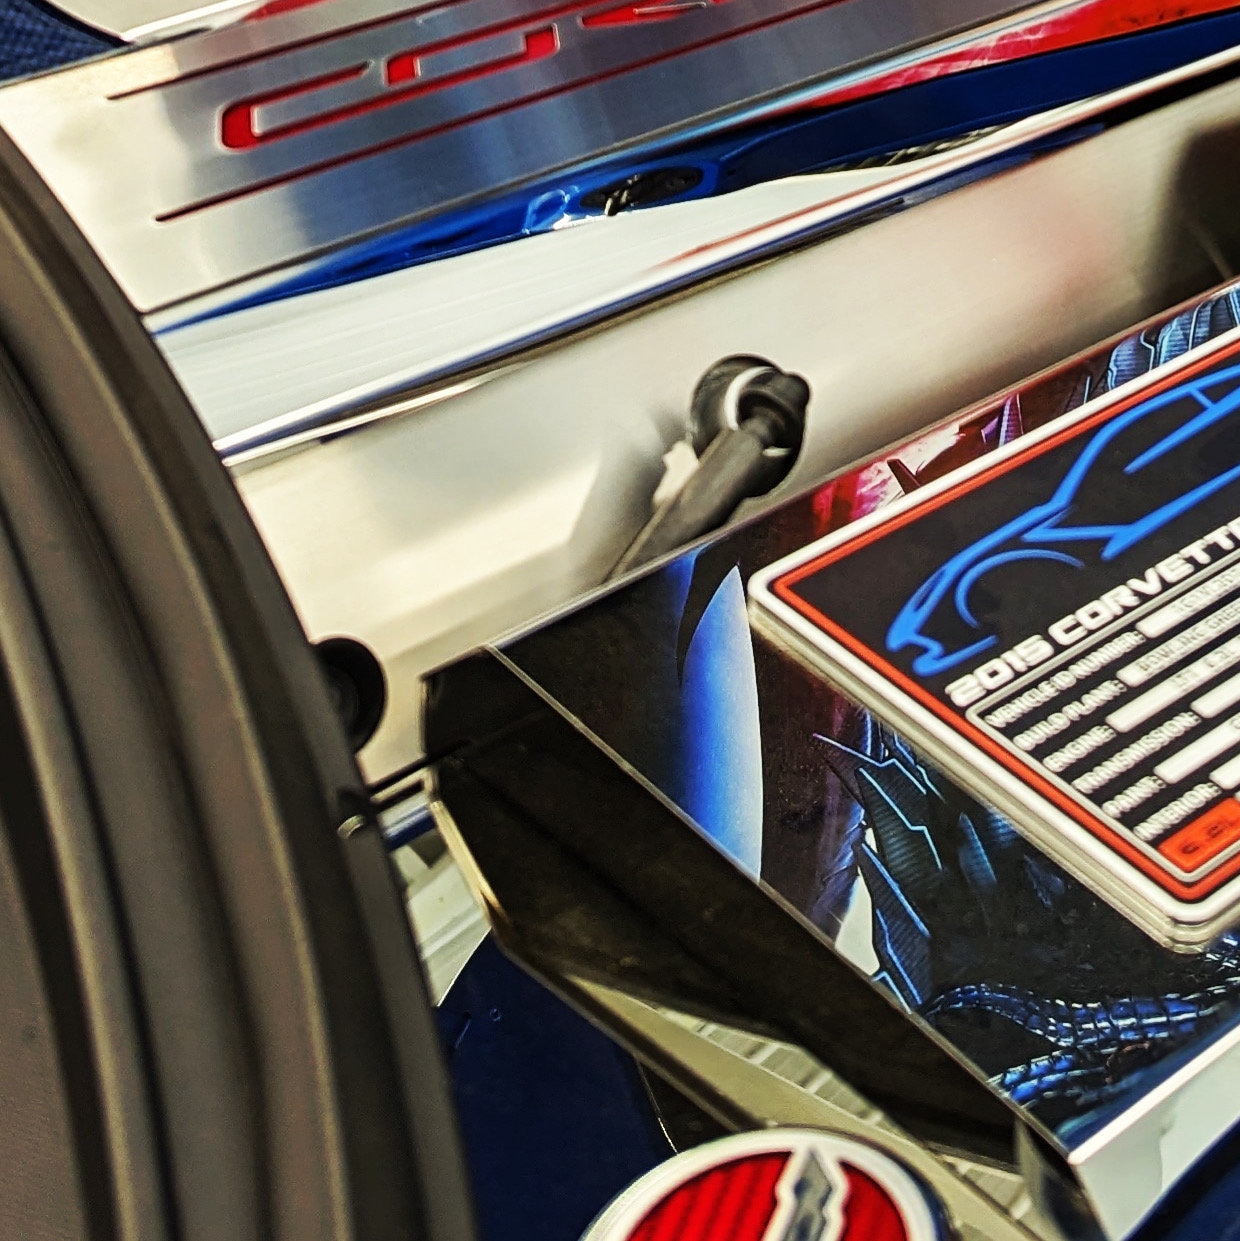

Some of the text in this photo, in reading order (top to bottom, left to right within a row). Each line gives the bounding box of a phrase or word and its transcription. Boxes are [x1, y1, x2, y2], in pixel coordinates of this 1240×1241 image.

[944, 634, 1054, 707] 2015
[984, 680, 1059, 727] VEHICLE
[1049, 670, 1076, 689] ID
[1067, 630, 1145, 678] NUMBER:
[1012, 712, 1071, 750] BUILD
[1061, 679, 1126, 720] PLANT:
[1042, 725, 1116, 772] ENGINE:
[1071, 711, 1200, 793] TRANSMISSION:
[1101, 775, 1165, 818] PAINT:
[1133, 782, 1221, 840] INTERIOR:
